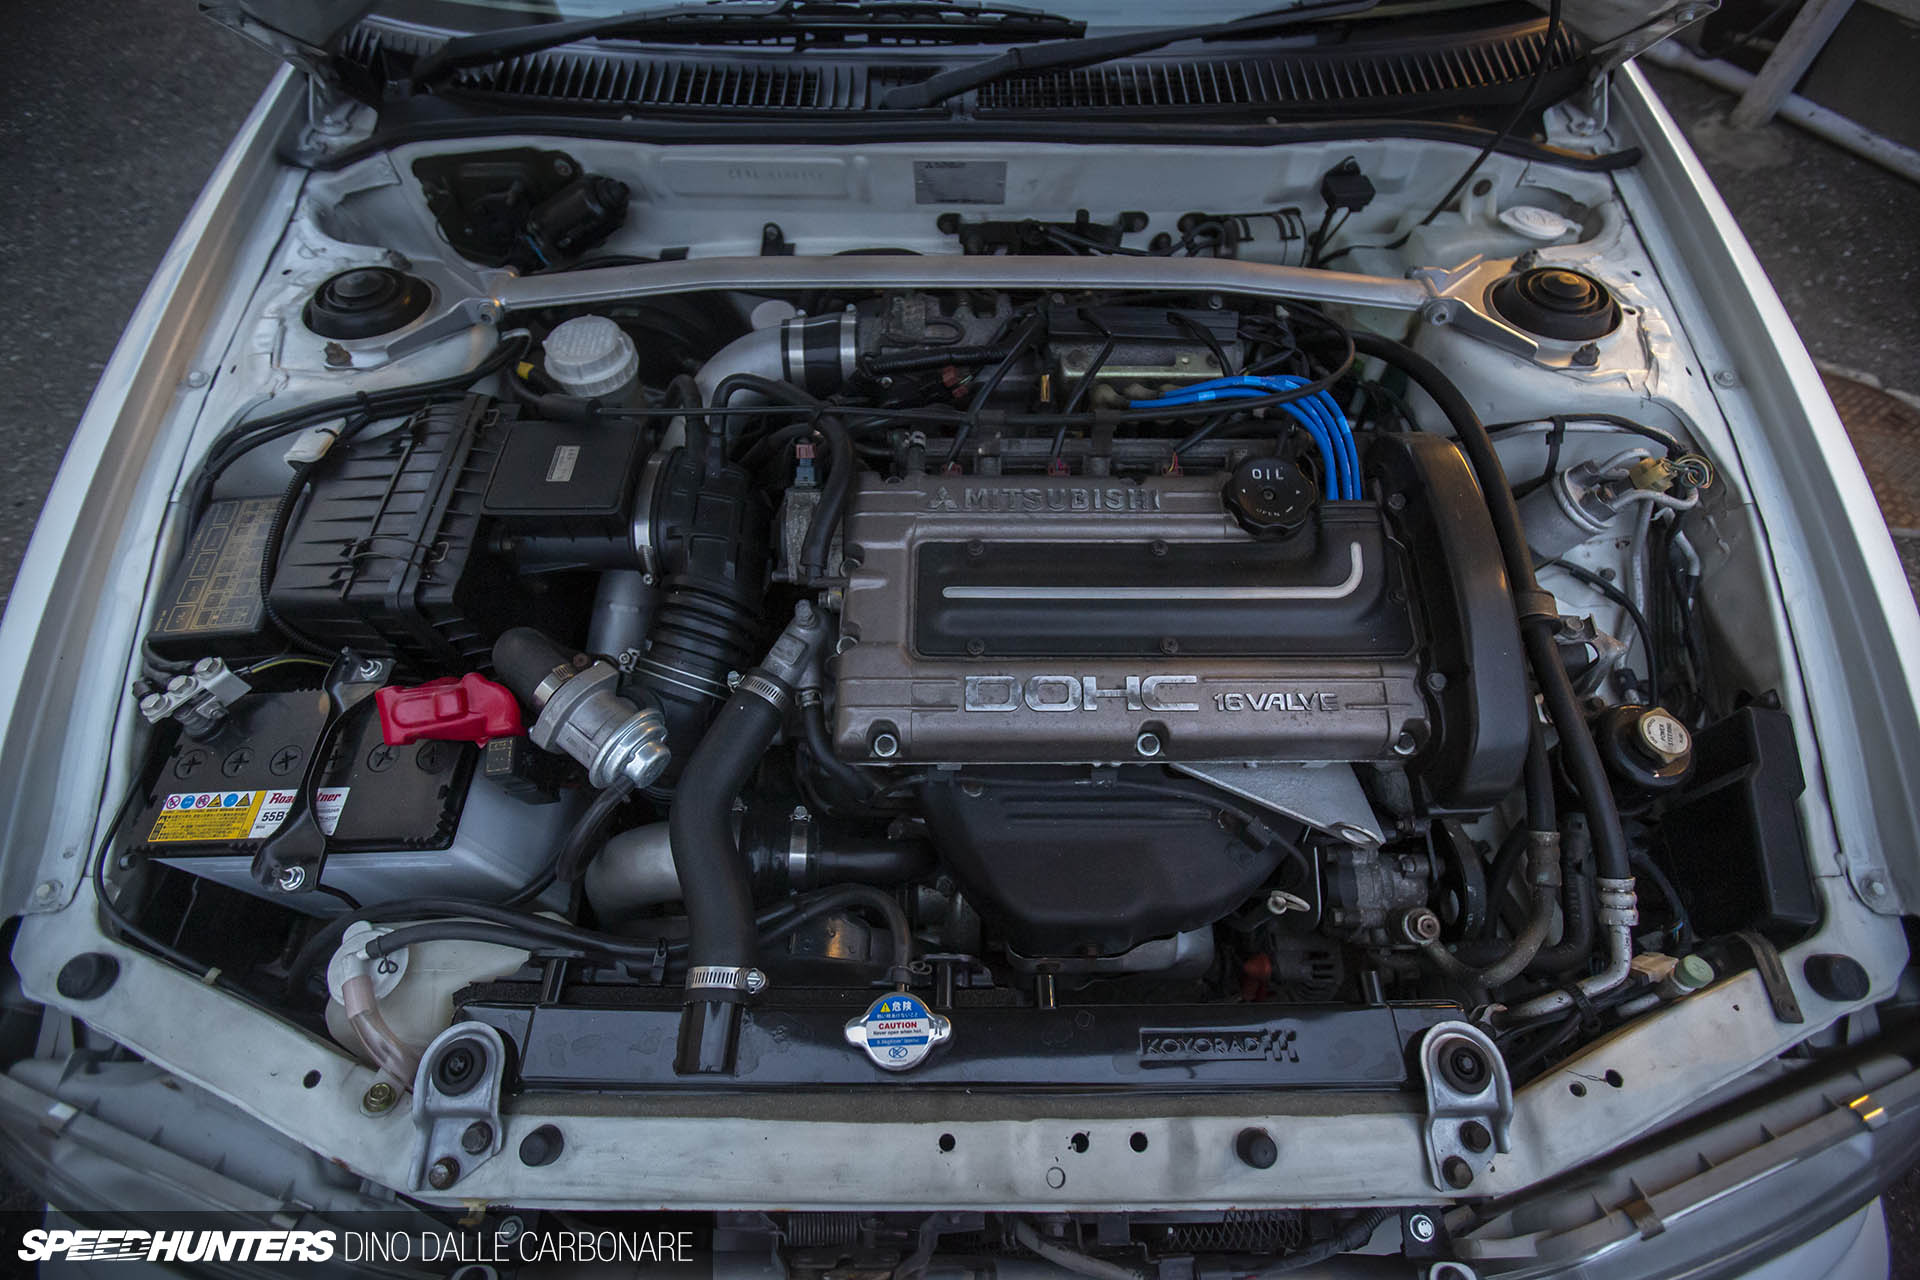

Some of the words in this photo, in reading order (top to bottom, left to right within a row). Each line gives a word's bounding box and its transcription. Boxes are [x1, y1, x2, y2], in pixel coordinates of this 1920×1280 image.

[1252, 468, 1284, 480] OIL
[962, 487, 1160, 512] MITSUBISHI
[965, 675, 1199, 712] DOHC
[892, 1001, 912, 1012] 危険
[878, 1021, 917, 1030] CAUTION
[1147, 1037, 1260, 1055] KOYORAD
